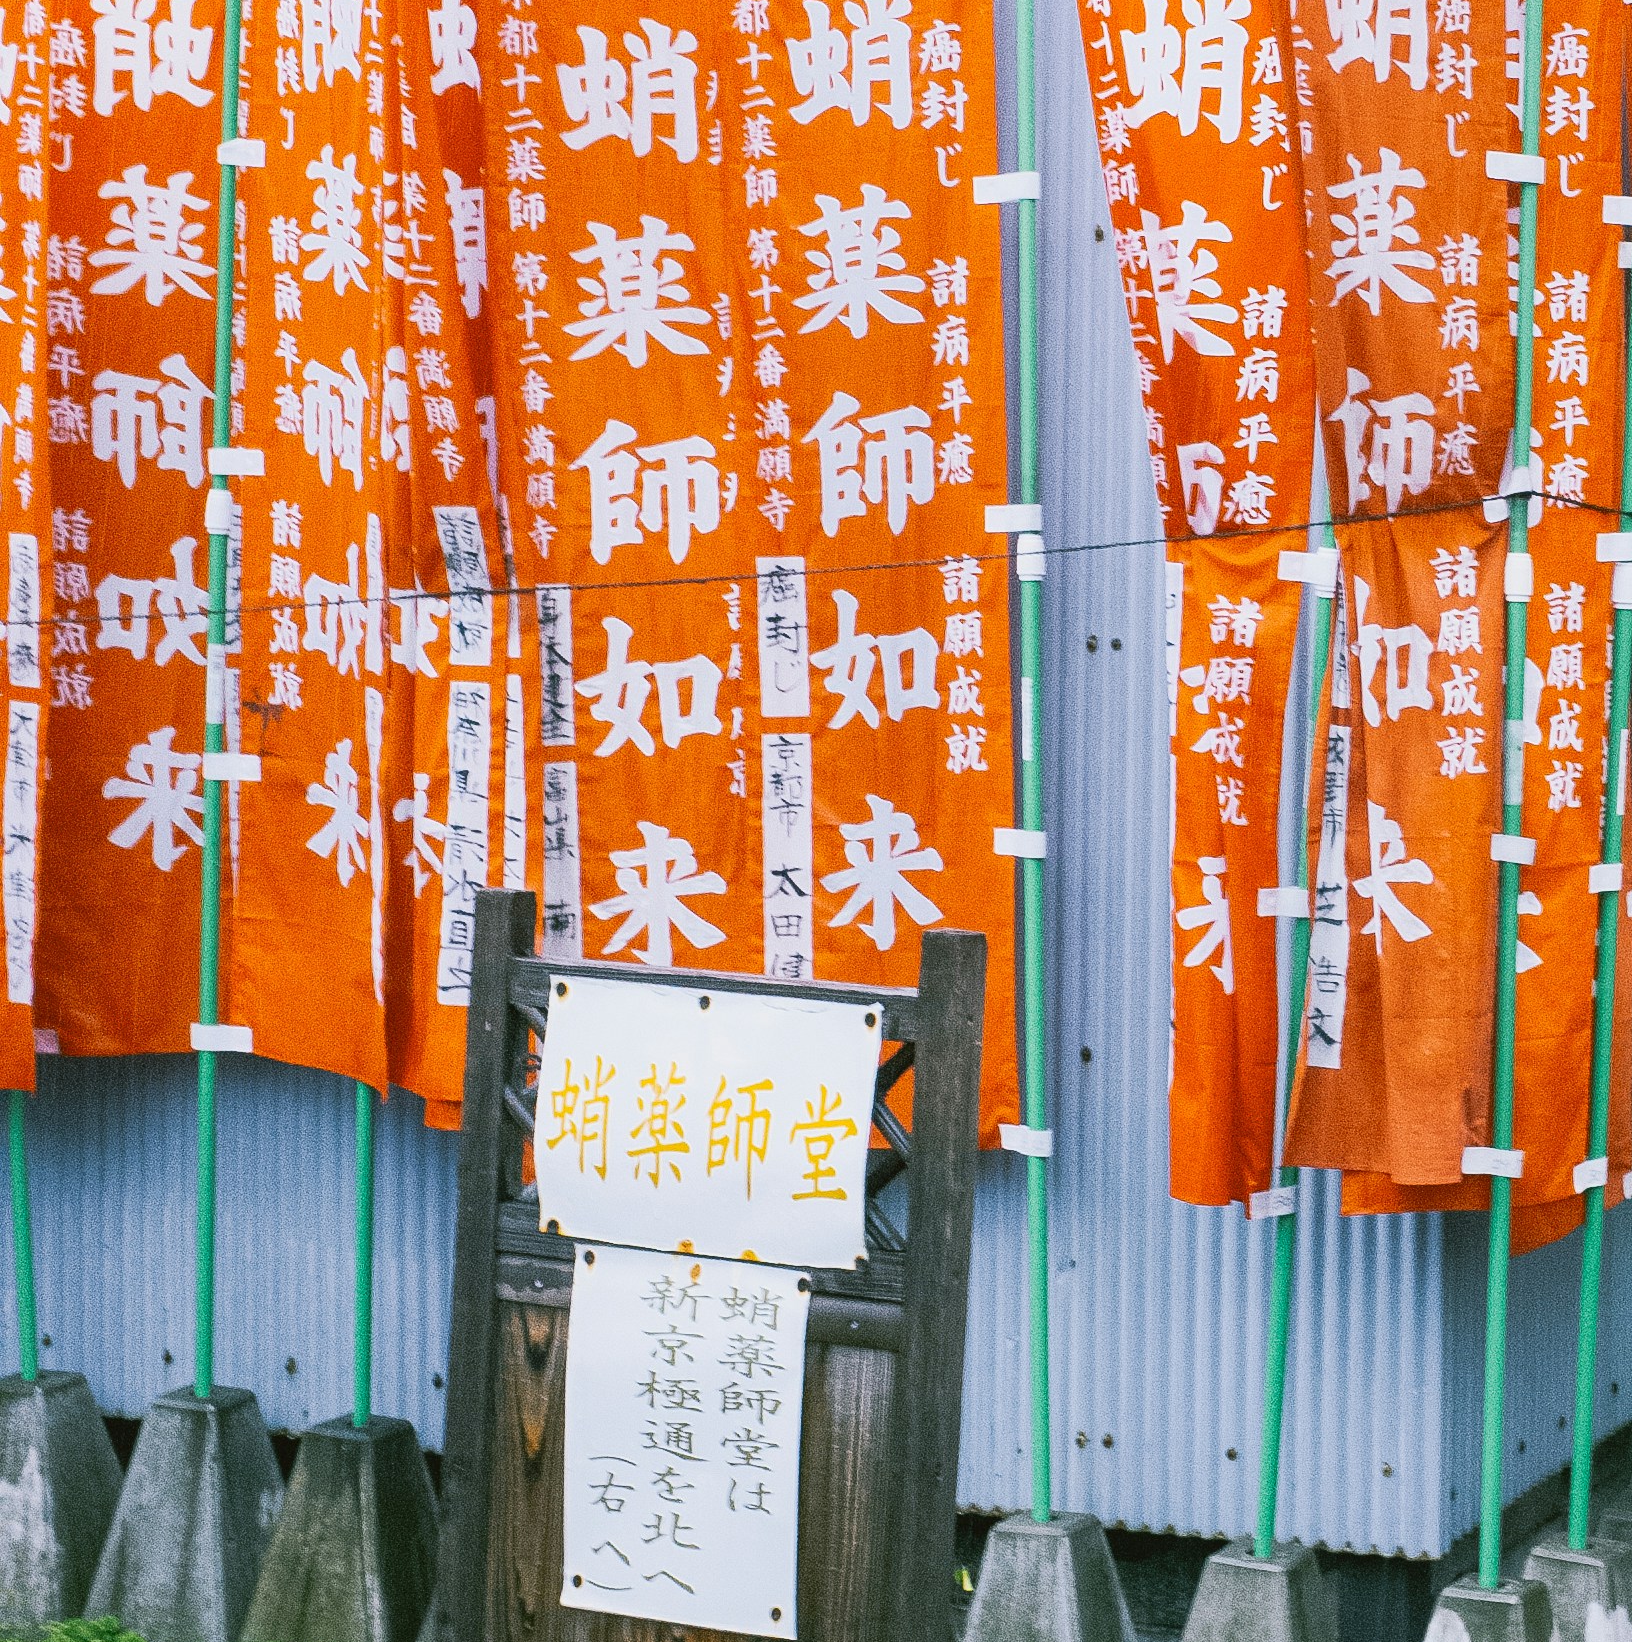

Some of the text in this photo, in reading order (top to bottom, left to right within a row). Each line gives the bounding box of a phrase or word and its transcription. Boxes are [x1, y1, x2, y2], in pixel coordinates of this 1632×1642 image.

[919, 19, 988, 772] 癌封じ 諸病平癒 諸願成就
[1221, 285, 1287, 524] 諸病平癒
[1436, 233, 1481, 475] 諸病平癒
[1543, 23, 1594, 811] 癌封じ 諸病平癒 諸願成就
[556, 18, 728, 965] 蛸薬師如来
[758, 566, 808, 693] 癌封じ
[1429, 546, 1487, 779] 諸願成就
[767, 735, 805, 837] 京都市
[547, 1056, 858, 1202] 蛸薬師堂
[637, 1274, 708, 1596] 新京極通を北へ
[719, 1285, 786, 1516] 蛸薬師堂は
